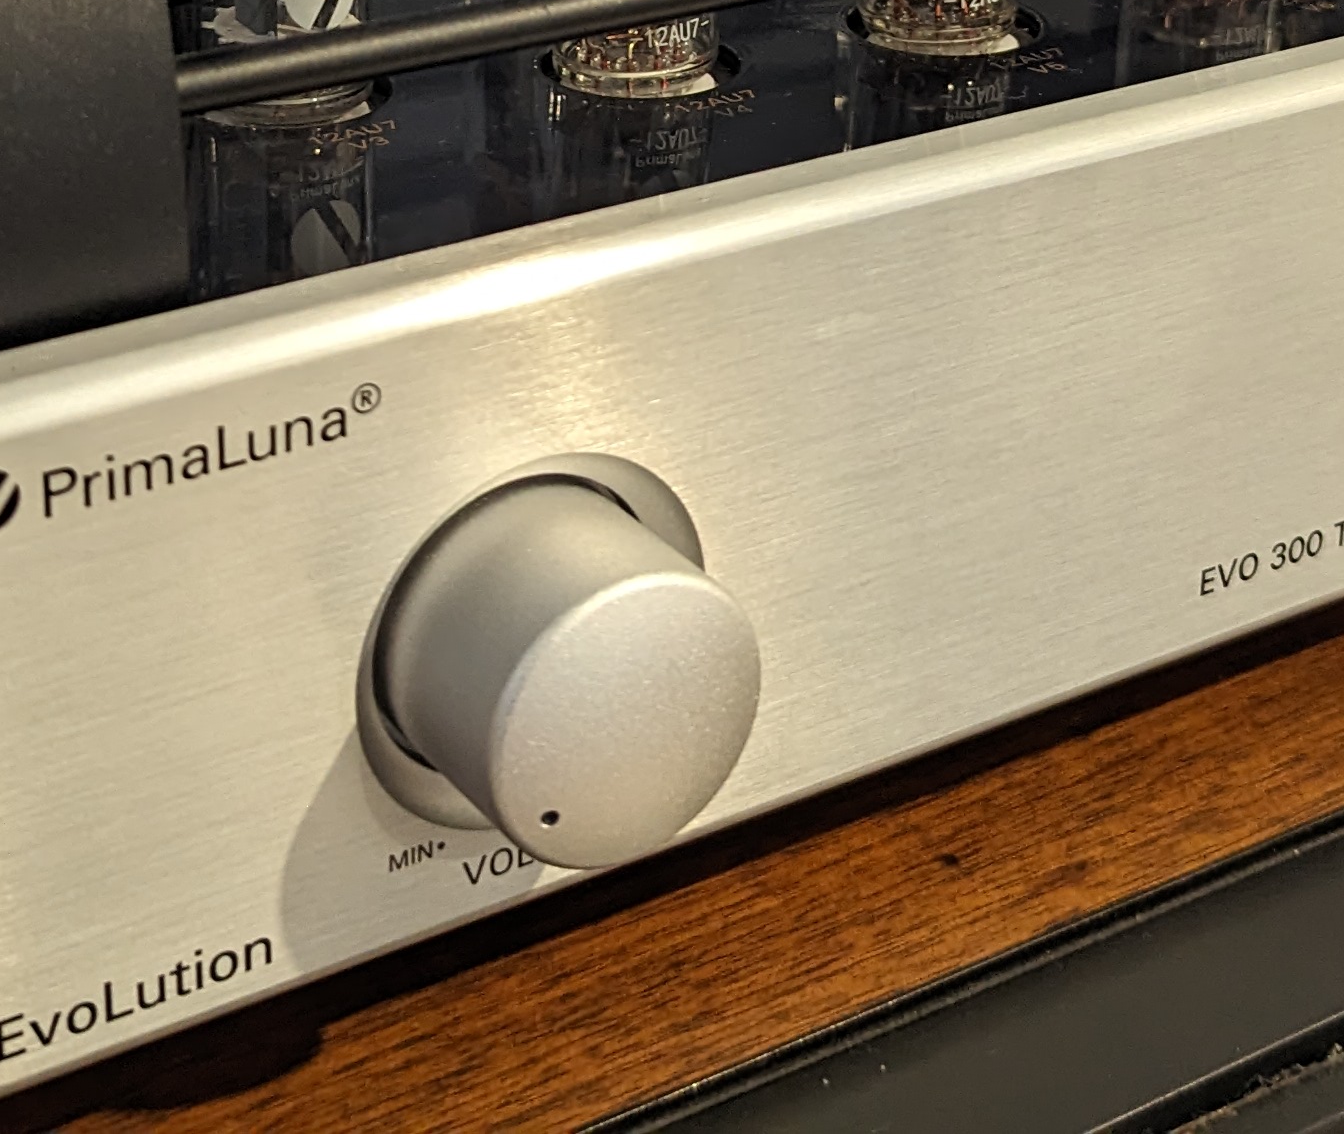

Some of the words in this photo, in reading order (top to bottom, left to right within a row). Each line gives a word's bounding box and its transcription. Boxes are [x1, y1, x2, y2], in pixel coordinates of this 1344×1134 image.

[1199, 552, 1259, 596] EVO
[1270, 529, 1324, 570] 300
[388, 840, 434, 873] MIN
